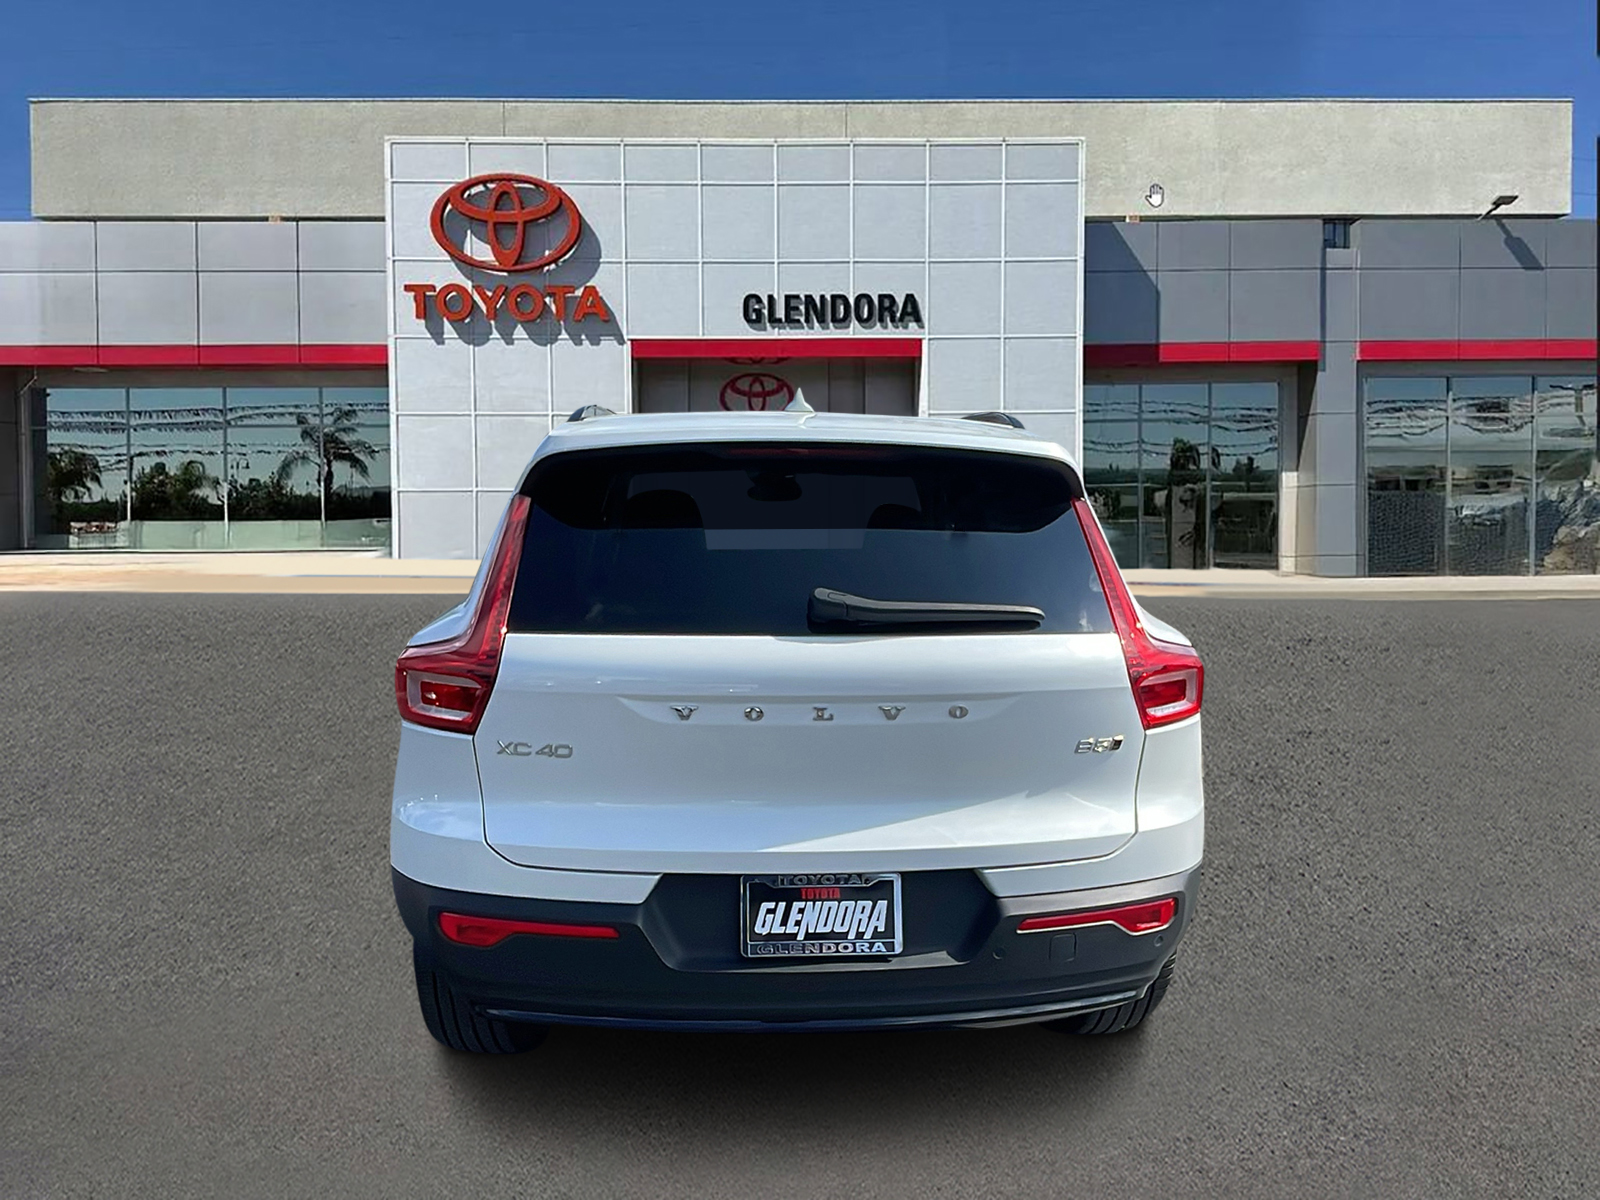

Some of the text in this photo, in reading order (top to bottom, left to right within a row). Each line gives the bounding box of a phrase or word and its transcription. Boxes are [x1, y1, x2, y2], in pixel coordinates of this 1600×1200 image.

[404, 283, 610, 322] TOYOTA
[743, 293, 922, 325] GLENDORA
[670, 704, 969, 722] VOLVO
[780, 874, 862, 886] TOYOTA
[801, 888, 840, 899] TOYOTA
[754, 900, 888, 941] GLENDORA
[756, 942, 887, 955] GLENDORA
